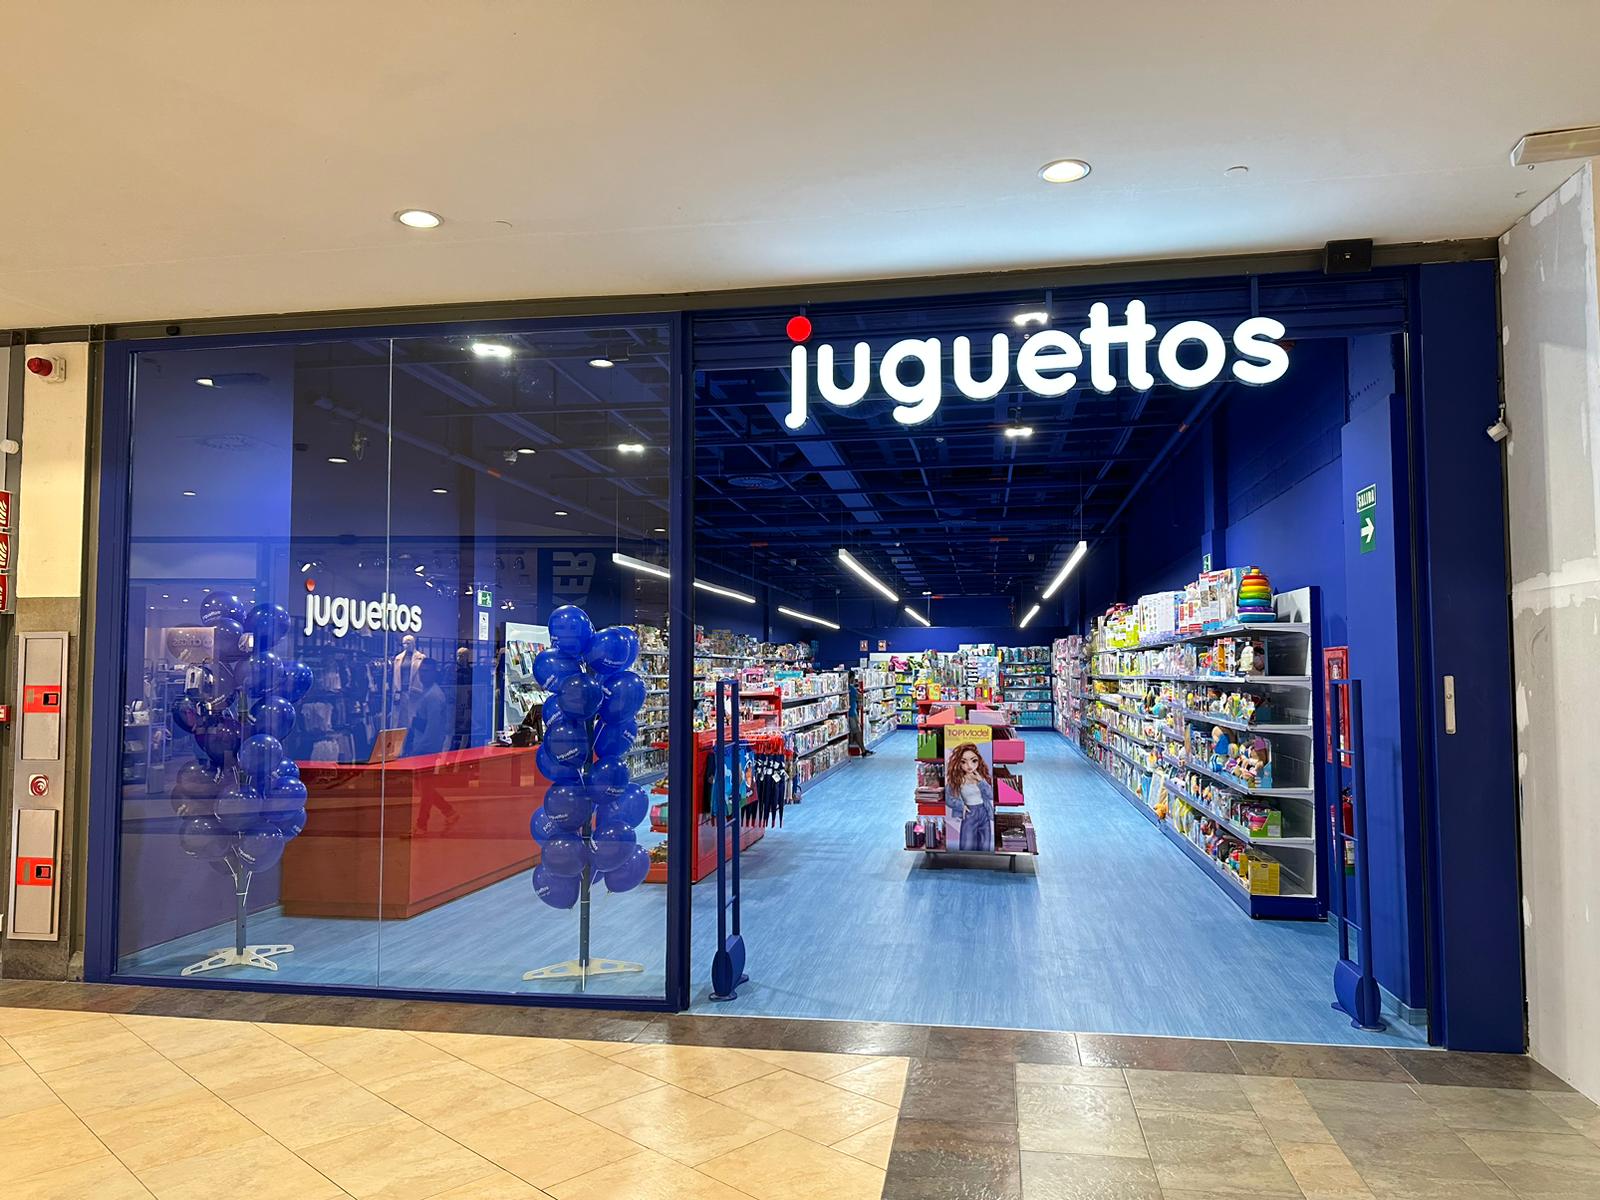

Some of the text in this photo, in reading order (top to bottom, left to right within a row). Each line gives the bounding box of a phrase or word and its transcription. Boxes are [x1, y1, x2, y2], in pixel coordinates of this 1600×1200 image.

[784, 299, 1289, 430] juguettos
[1358, 490, 1375, 508] SALIDA
[304, 578, 422, 638] juguettos
